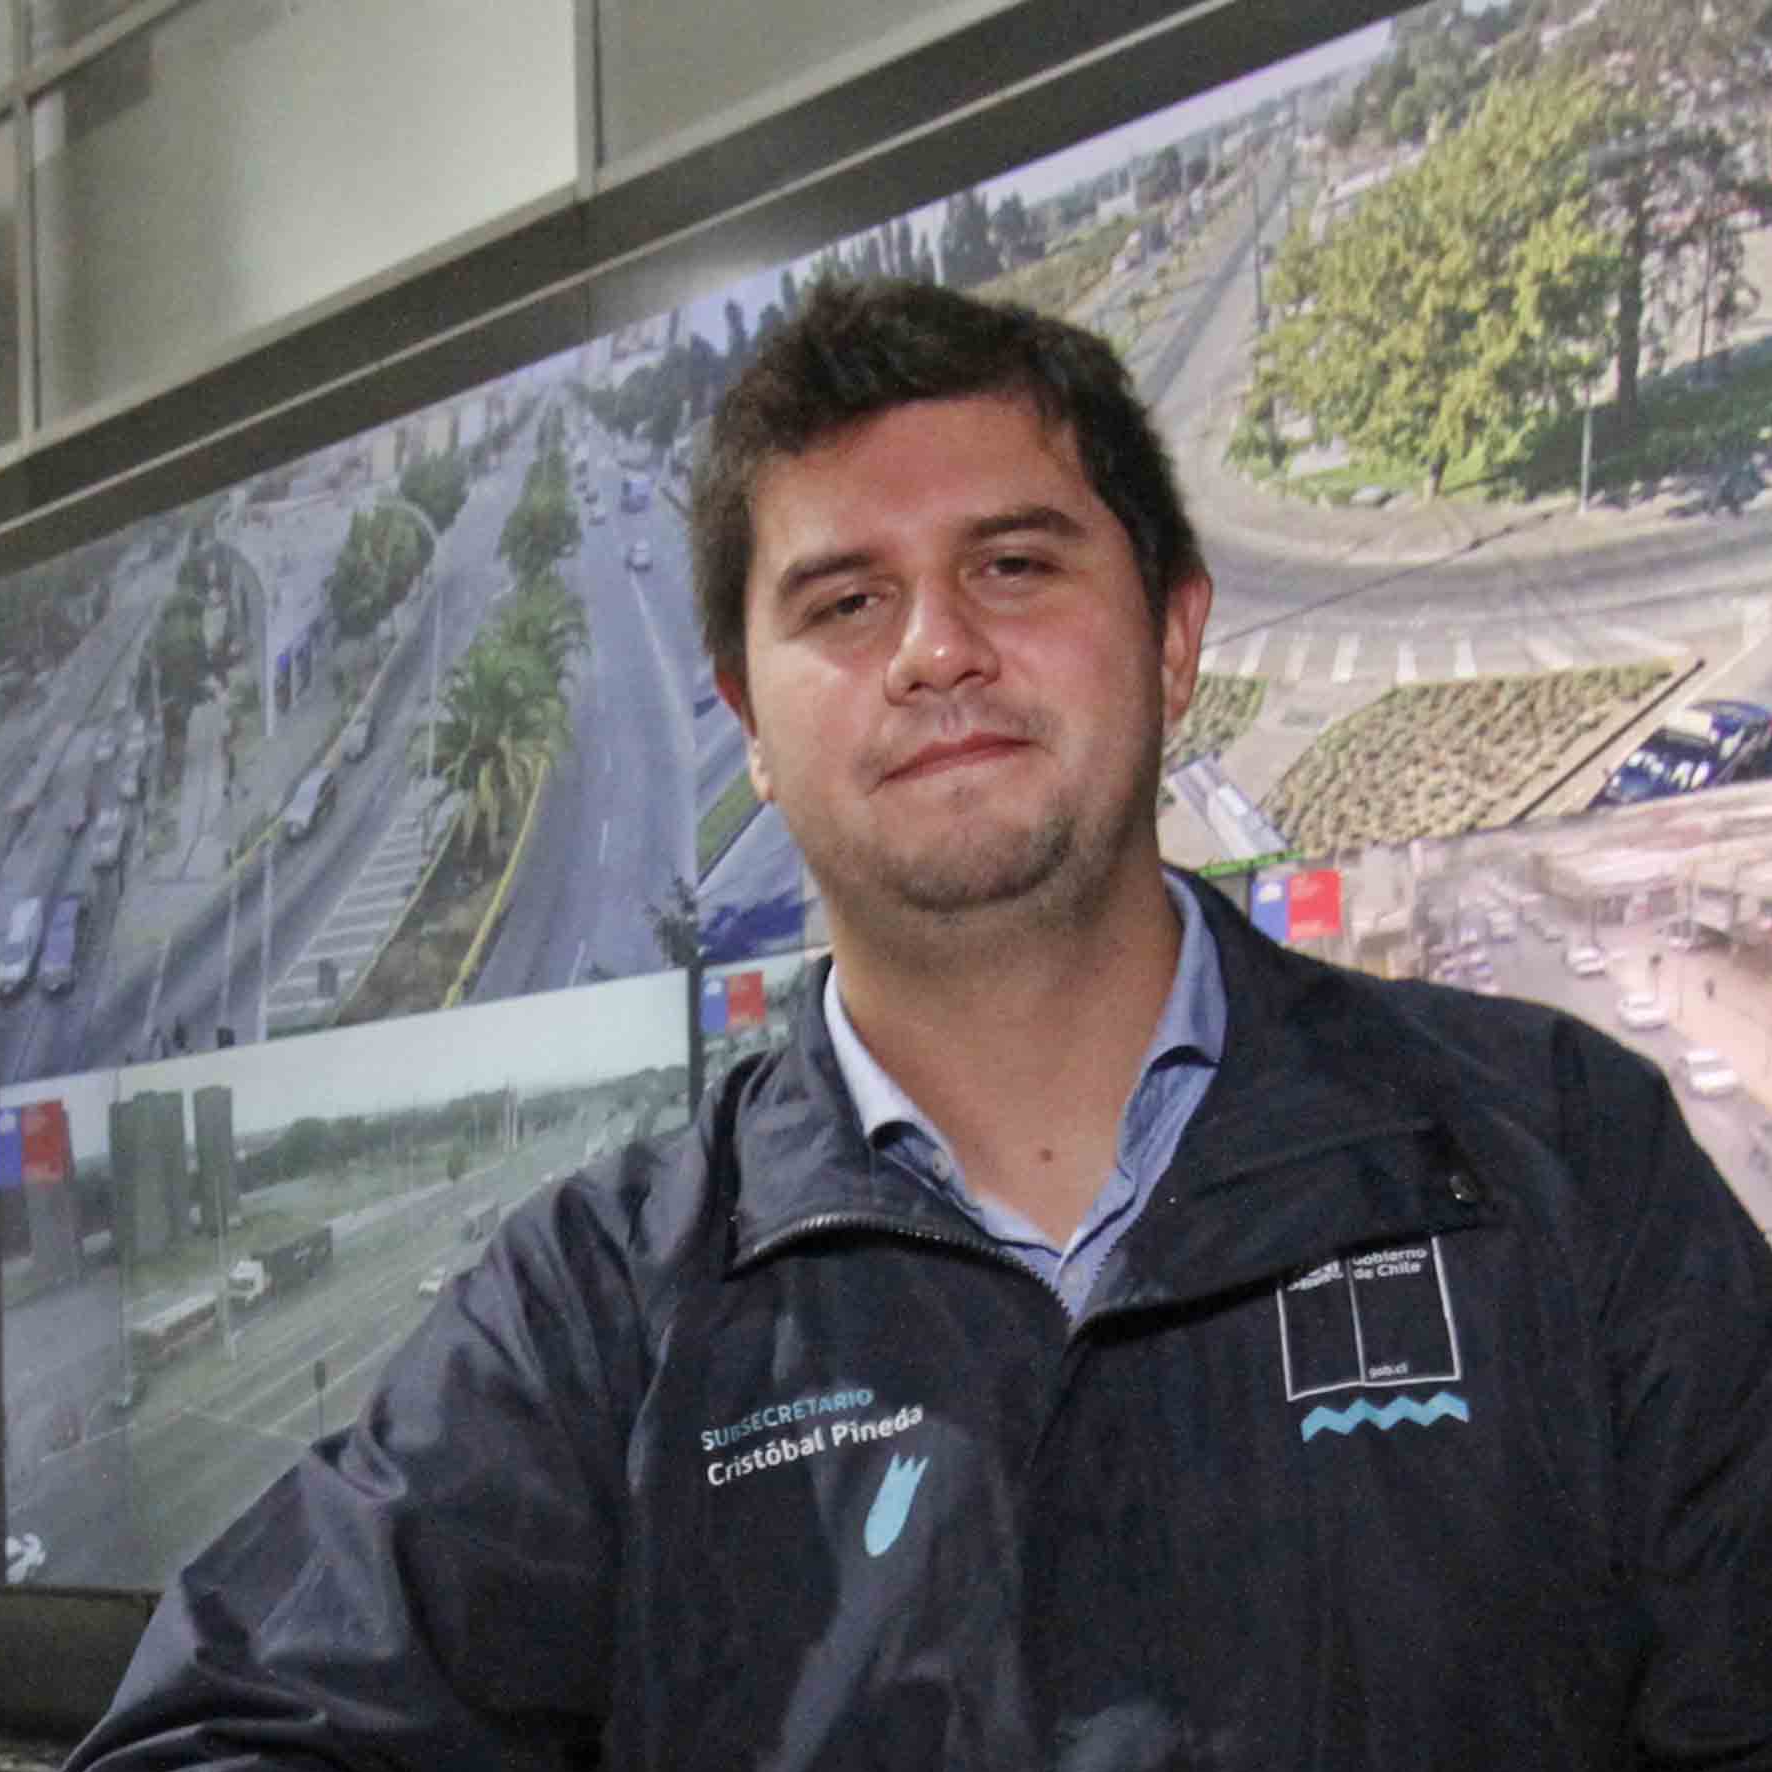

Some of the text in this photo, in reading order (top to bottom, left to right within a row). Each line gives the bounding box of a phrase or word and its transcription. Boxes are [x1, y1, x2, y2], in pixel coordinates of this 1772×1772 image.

[1353, 1261, 1422, 1279] de Chile
[700, 1388, 874, 1451] SUBSECRETARIO
[707, 1404, 924, 1486] Cristóbal Pineda
